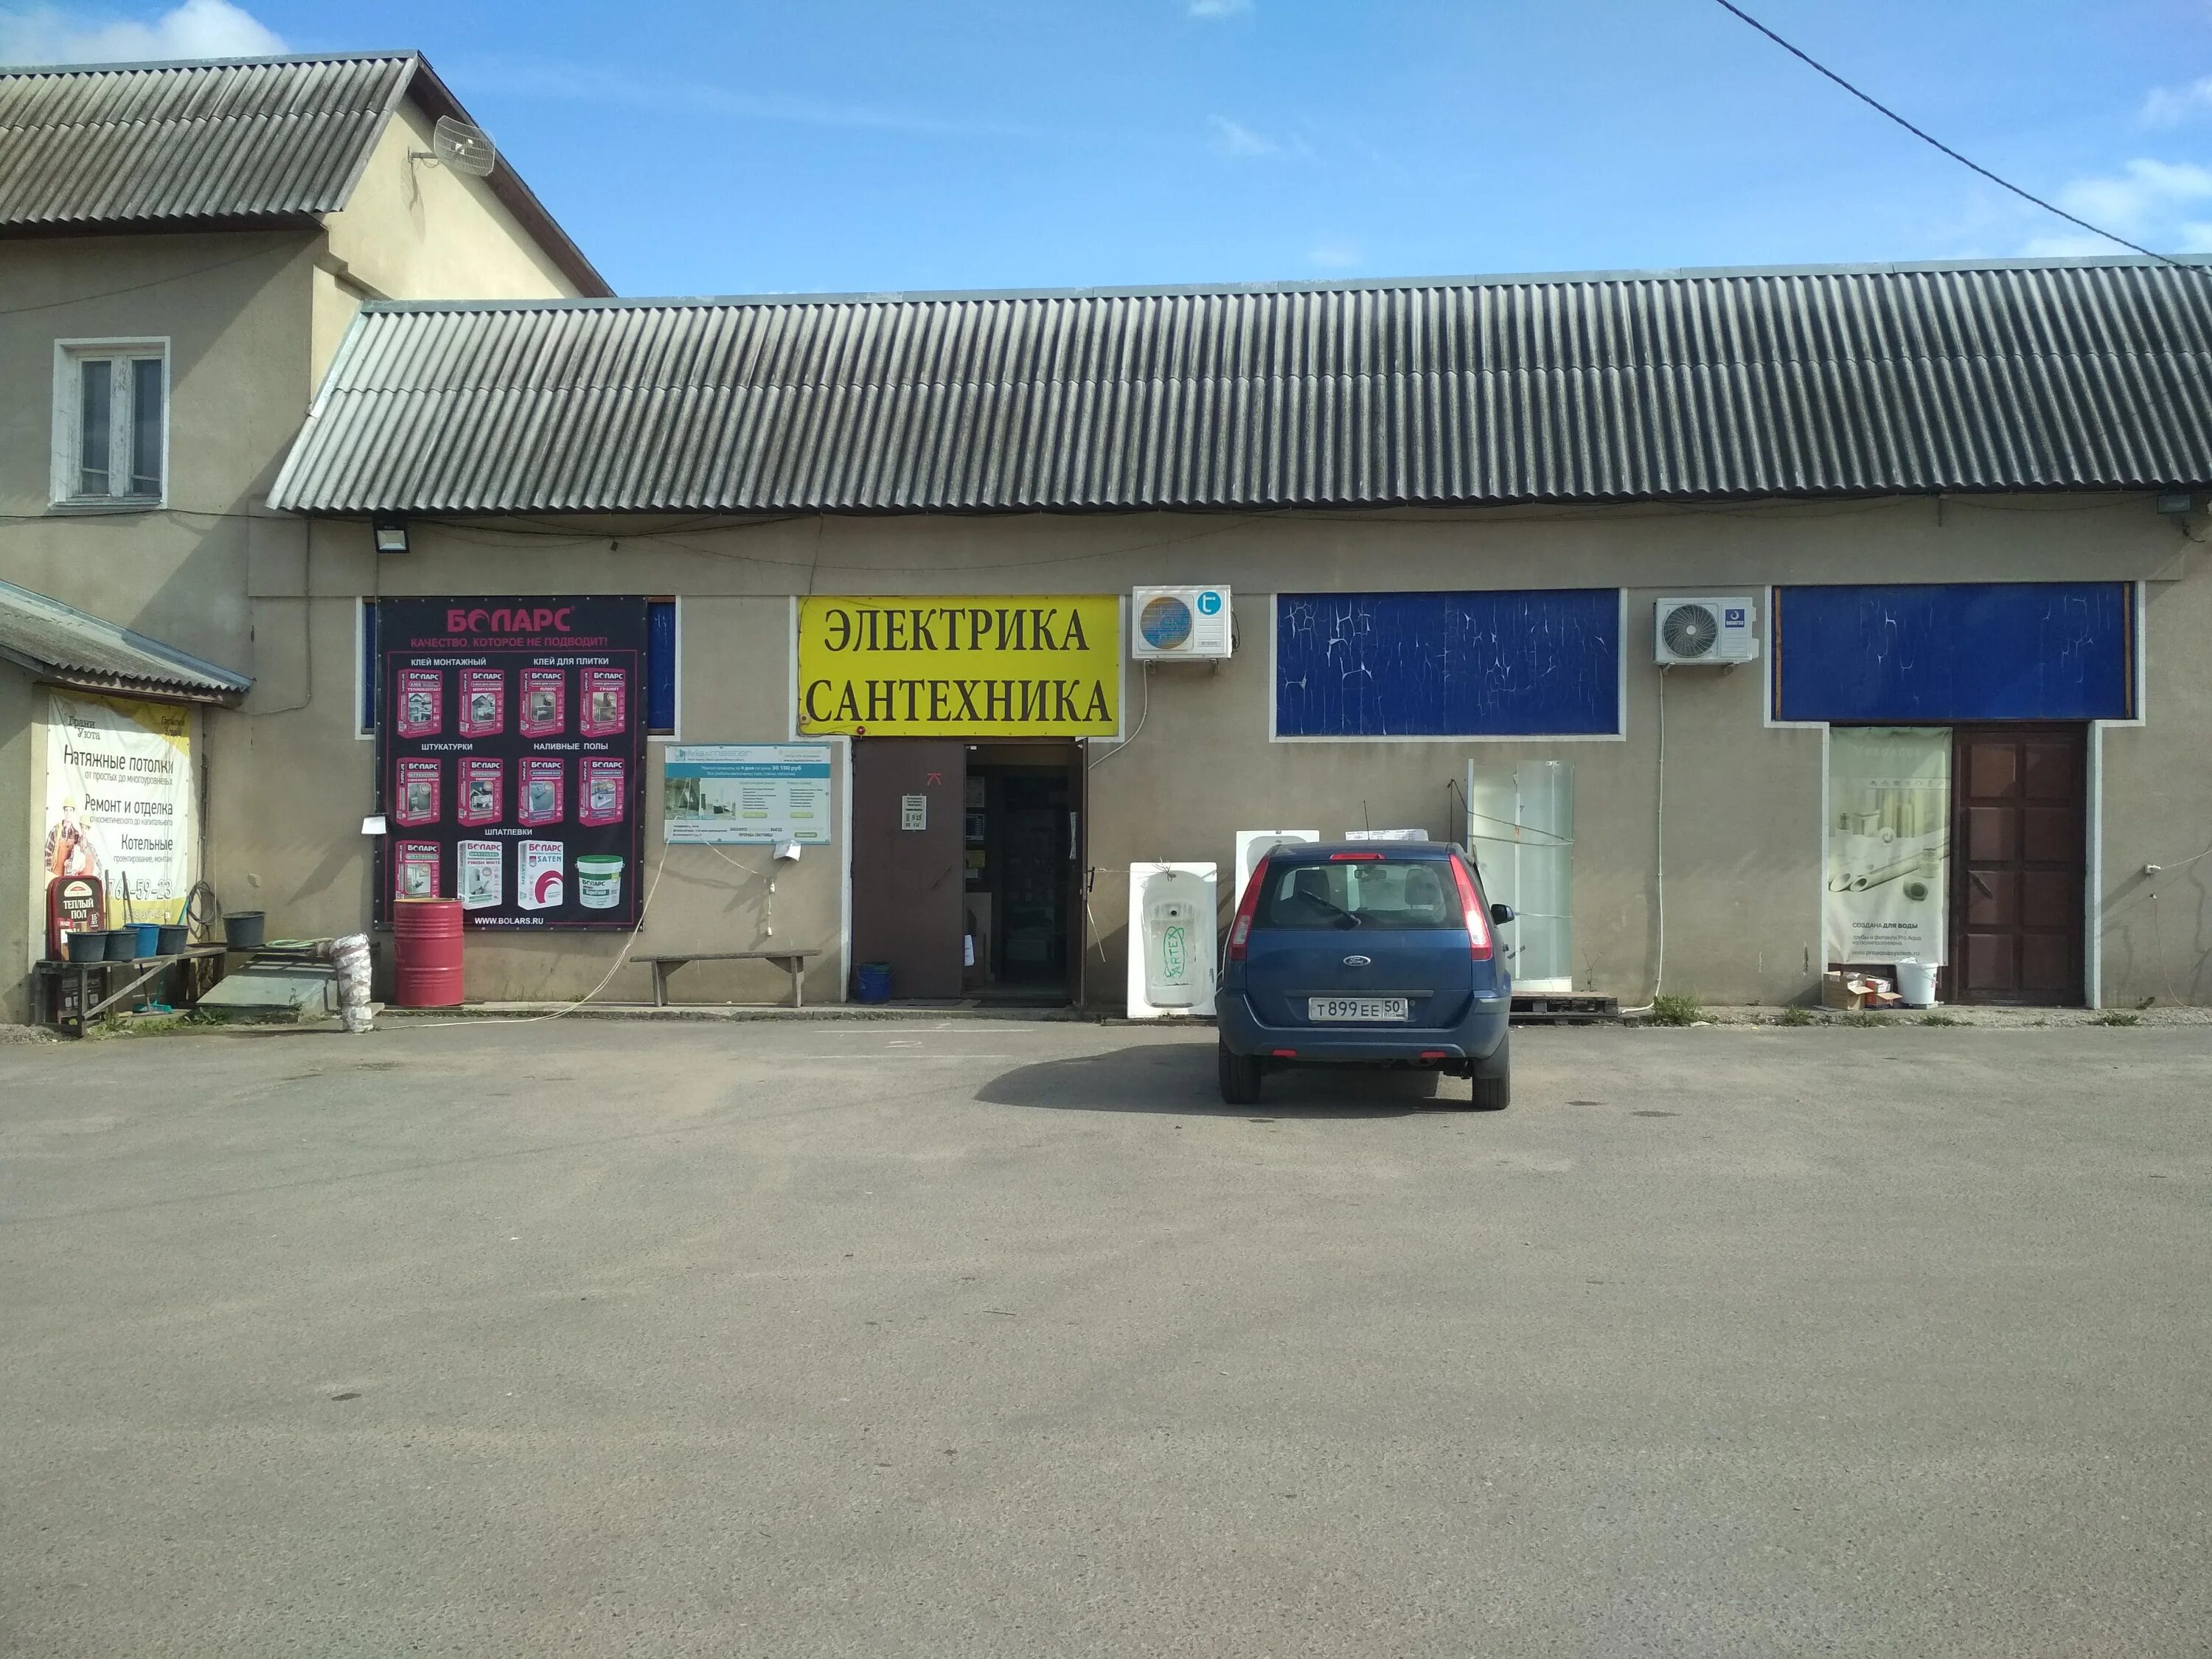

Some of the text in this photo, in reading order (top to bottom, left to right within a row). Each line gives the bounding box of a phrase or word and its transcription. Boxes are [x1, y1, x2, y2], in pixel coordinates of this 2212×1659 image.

[447, 608, 571, 633] БОЛАРС
[824, 608, 1090, 651] ЭЛЕКТРИКА
[473, 638, 524, 647] КОТОРОЕ
[526, 638, 542, 647] НЕ
[544, 637, 608, 647] ПОДВОДИТ!
[411, 657, 487, 666] КЛЕЙ МОНТАЖНЫЙ
[533, 657, 554, 665] КЛЕЙ
[557, 658, 574, 666] ДЛЯ
[806, 679, 1113, 722] САНТЕХНИКА
[68, 716, 96, 728] Грани
[77, 727, 100, 740] Уюта
[64, 745, 173, 774] Натяжные потолки
[85, 771, 173, 786] от простых до многоуровневых
[85, 793, 173, 817] Ремонт и отделка
[122, 834, 173, 850] Котельные
[529, 844, 562, 852] БОЛАРС
[63, 897, 94, 909] ТЕПЛЫЙ
[71, 910, 87, 919] ПОЛ
[1385, 1001, 1400, 1012] 50
